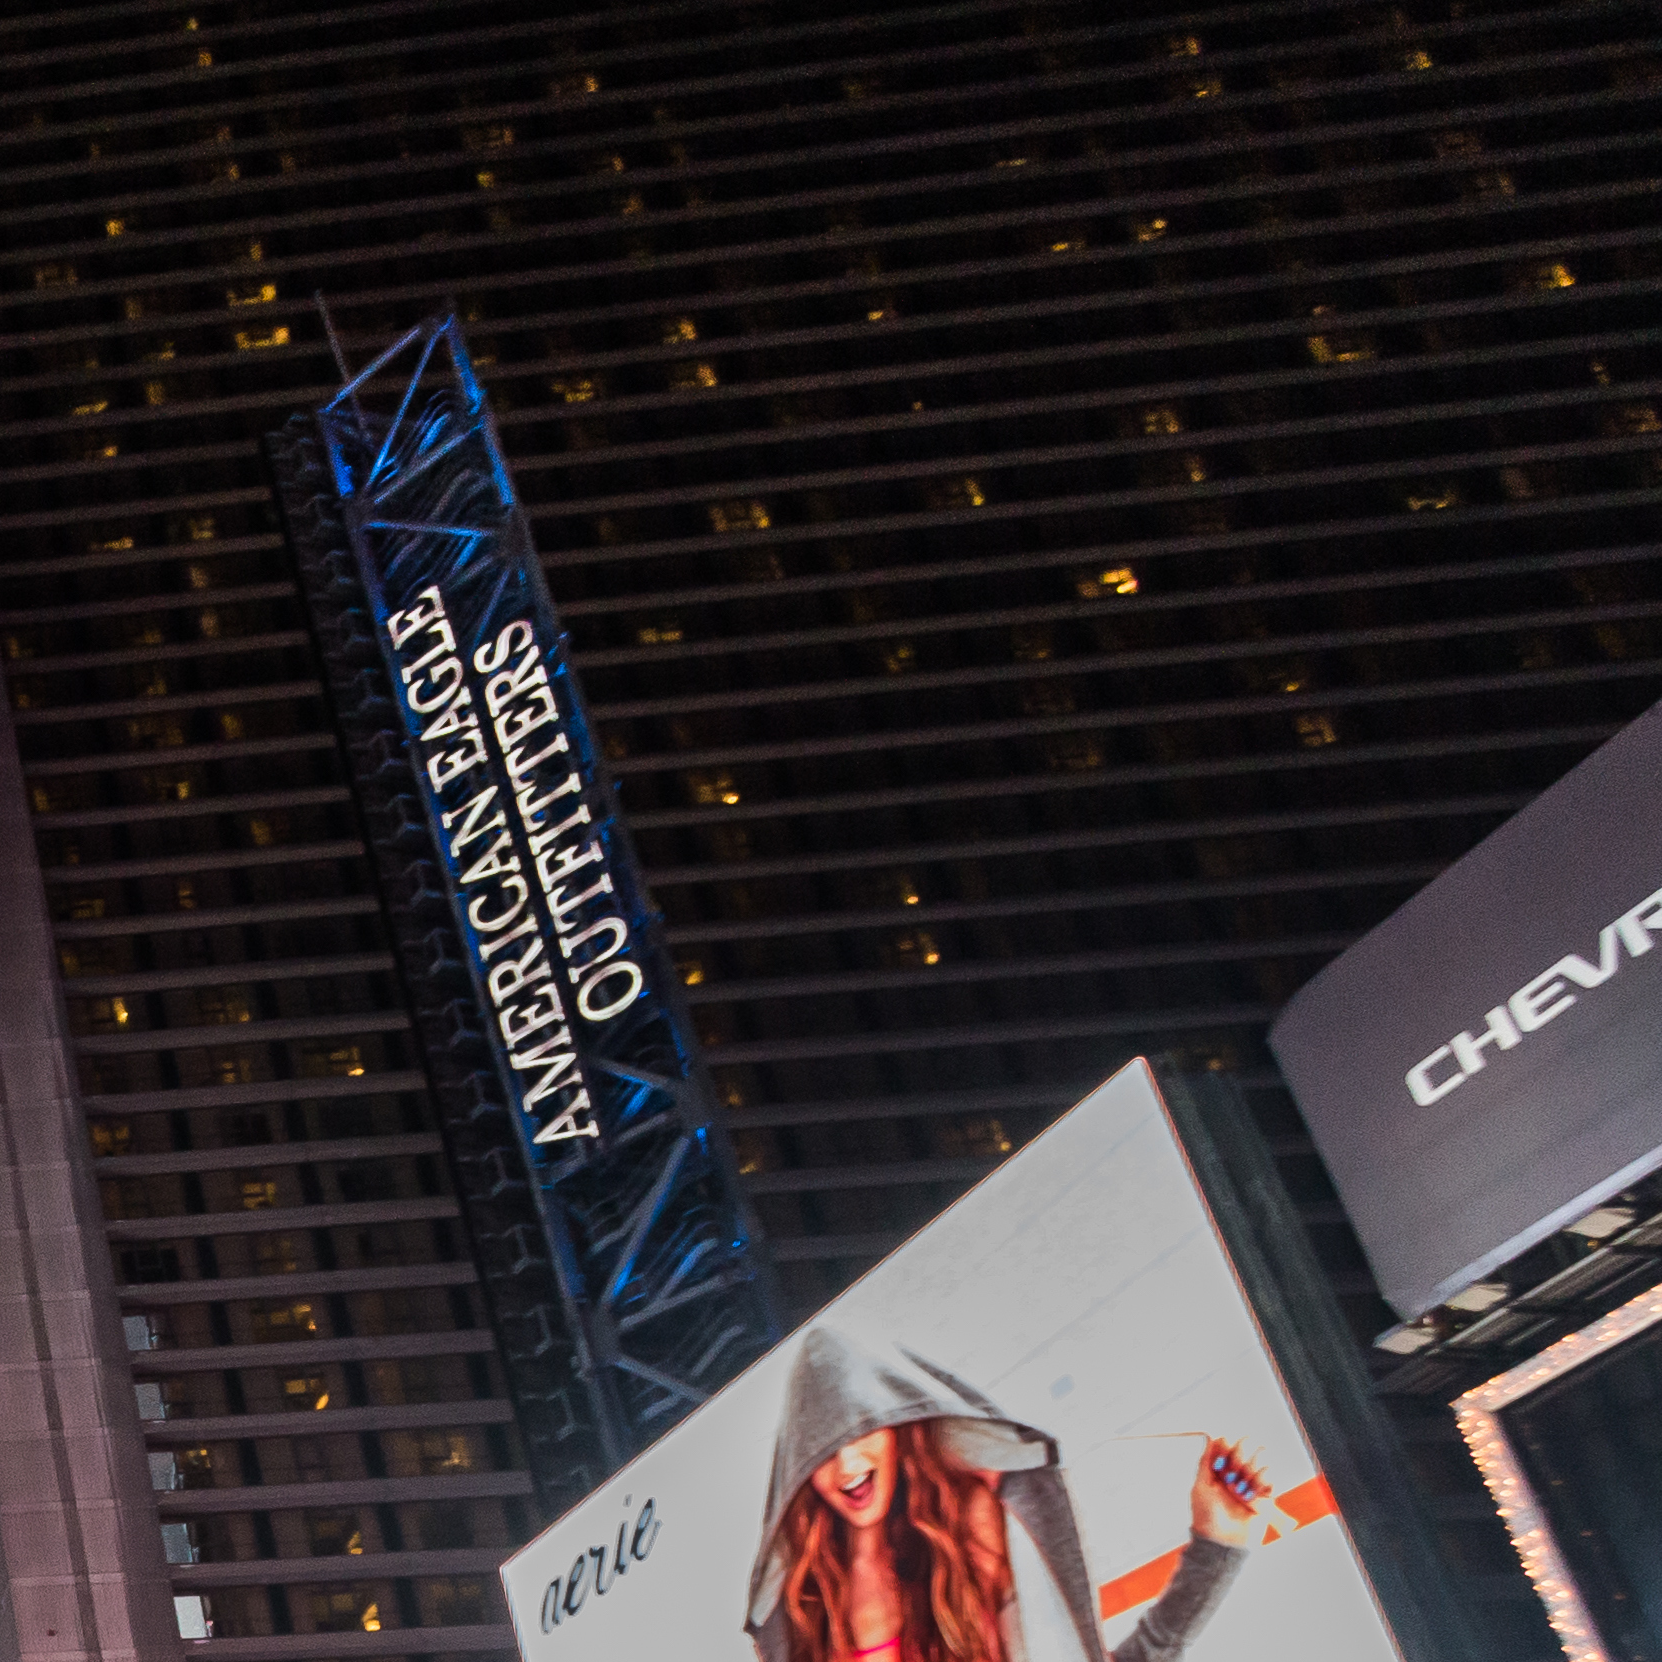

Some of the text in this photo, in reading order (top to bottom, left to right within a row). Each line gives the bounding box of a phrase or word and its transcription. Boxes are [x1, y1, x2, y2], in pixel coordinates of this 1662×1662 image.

[387, 585, 601, 1146] AMERICAN EAGLE
[473, 619, 644, 1022] OUTFITTERS
[541, 1494, 663, 1636] aerie
